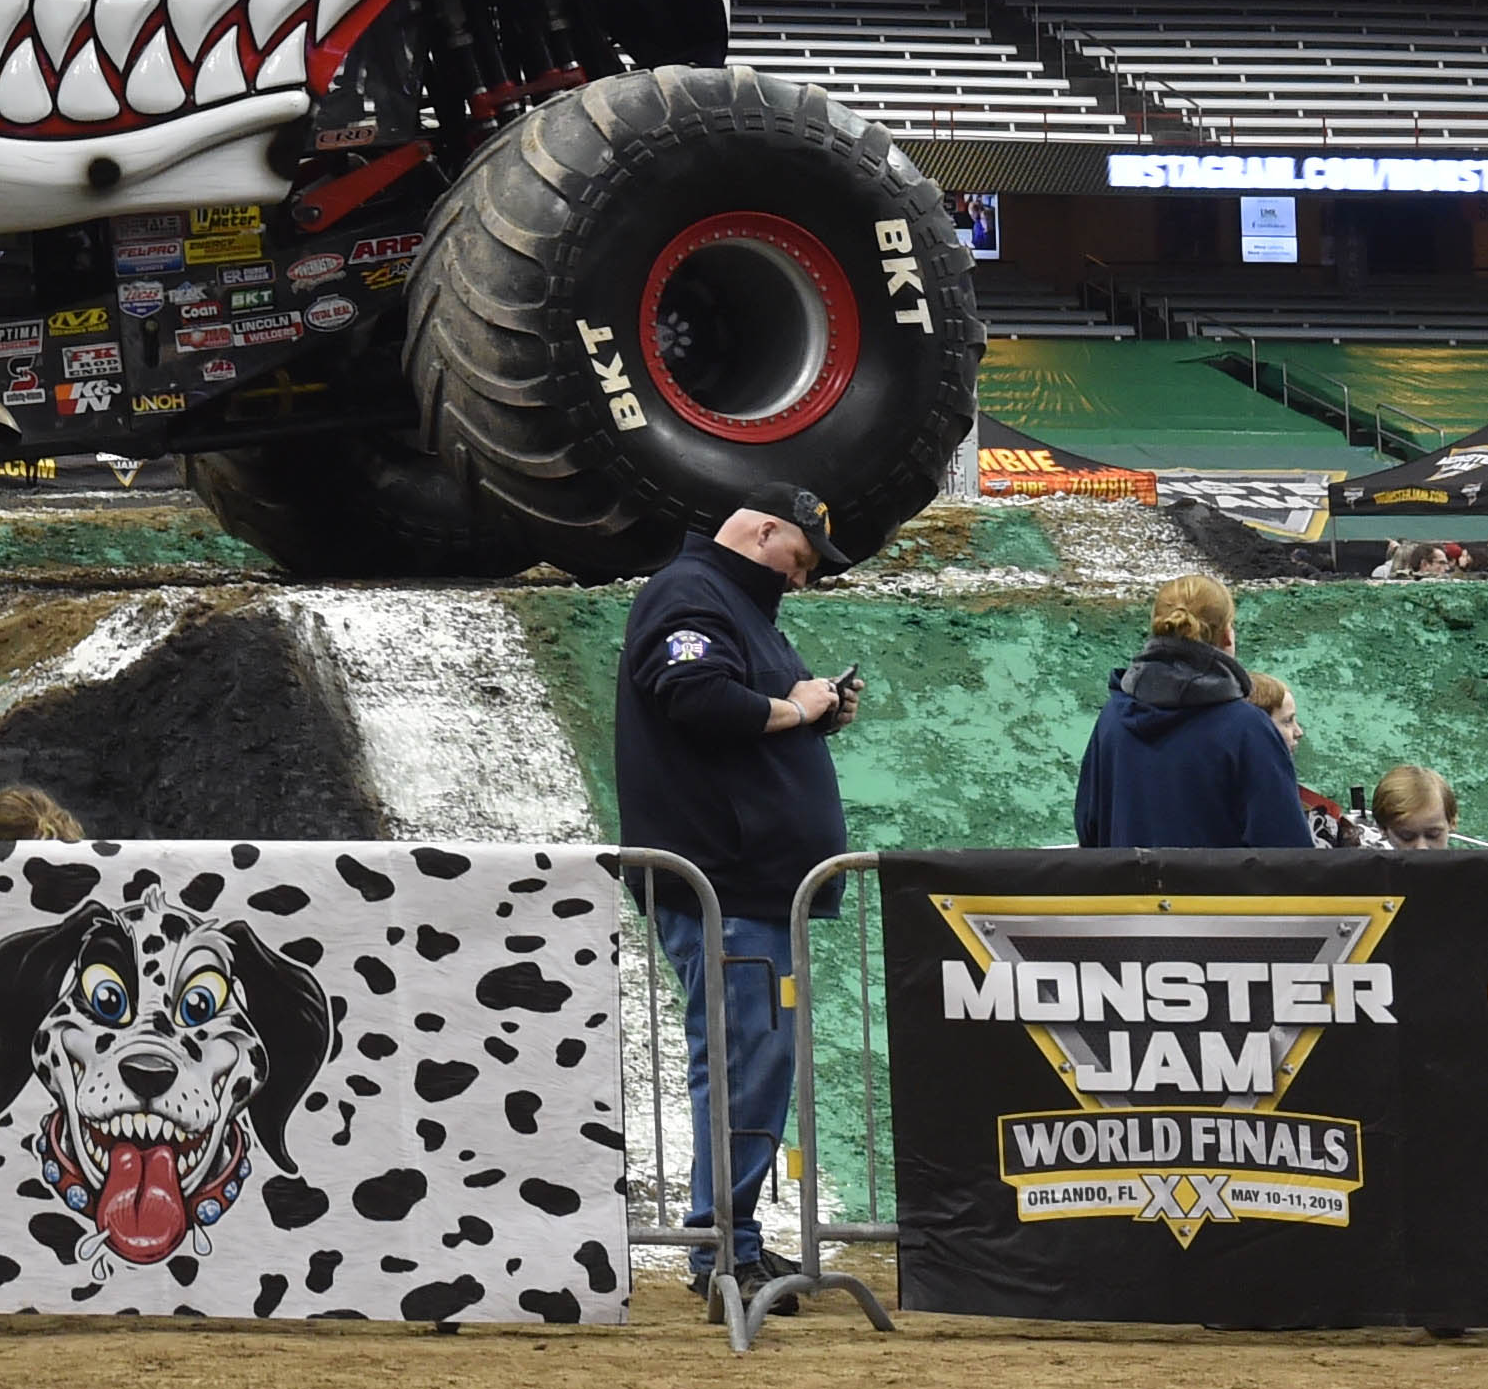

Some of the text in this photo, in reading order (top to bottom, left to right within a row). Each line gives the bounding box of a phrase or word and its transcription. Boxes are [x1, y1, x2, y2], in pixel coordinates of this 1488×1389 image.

[352, 235, 423, 261] ARP
[875, 218, 935, 335] BKT
[231, 291, 273, 308] BKT
[181, 305, 218, 319] Coan
[235, 314, 290, 334] LINCOLN
[248, 327, 297, 343] WELDERS
[68, 366, 120, 377] ENDS
[79, 360, 119, 369] ROD
[575, 318, 648, 432] BKT
[70, 379, 123, 414] K&N
[131, 393, 186, 411] UNOH
[1013, 481, 1049, 495] FIRE
[1068, 477, 1135, 499] ZOMBIE
[942, 959, 1399, 1024] MONSTER
[1075, 1030, 1275, 1093] JAM
[1012, 1117, 1350, 1173] WORLD FINALS
[1026, 1185, 1138, 1207] ORLANDO, FL
[1138, 1173, 1233, 1220] XX
[1231, 1187, 1343, 1212] MAY 10-11, 2019
